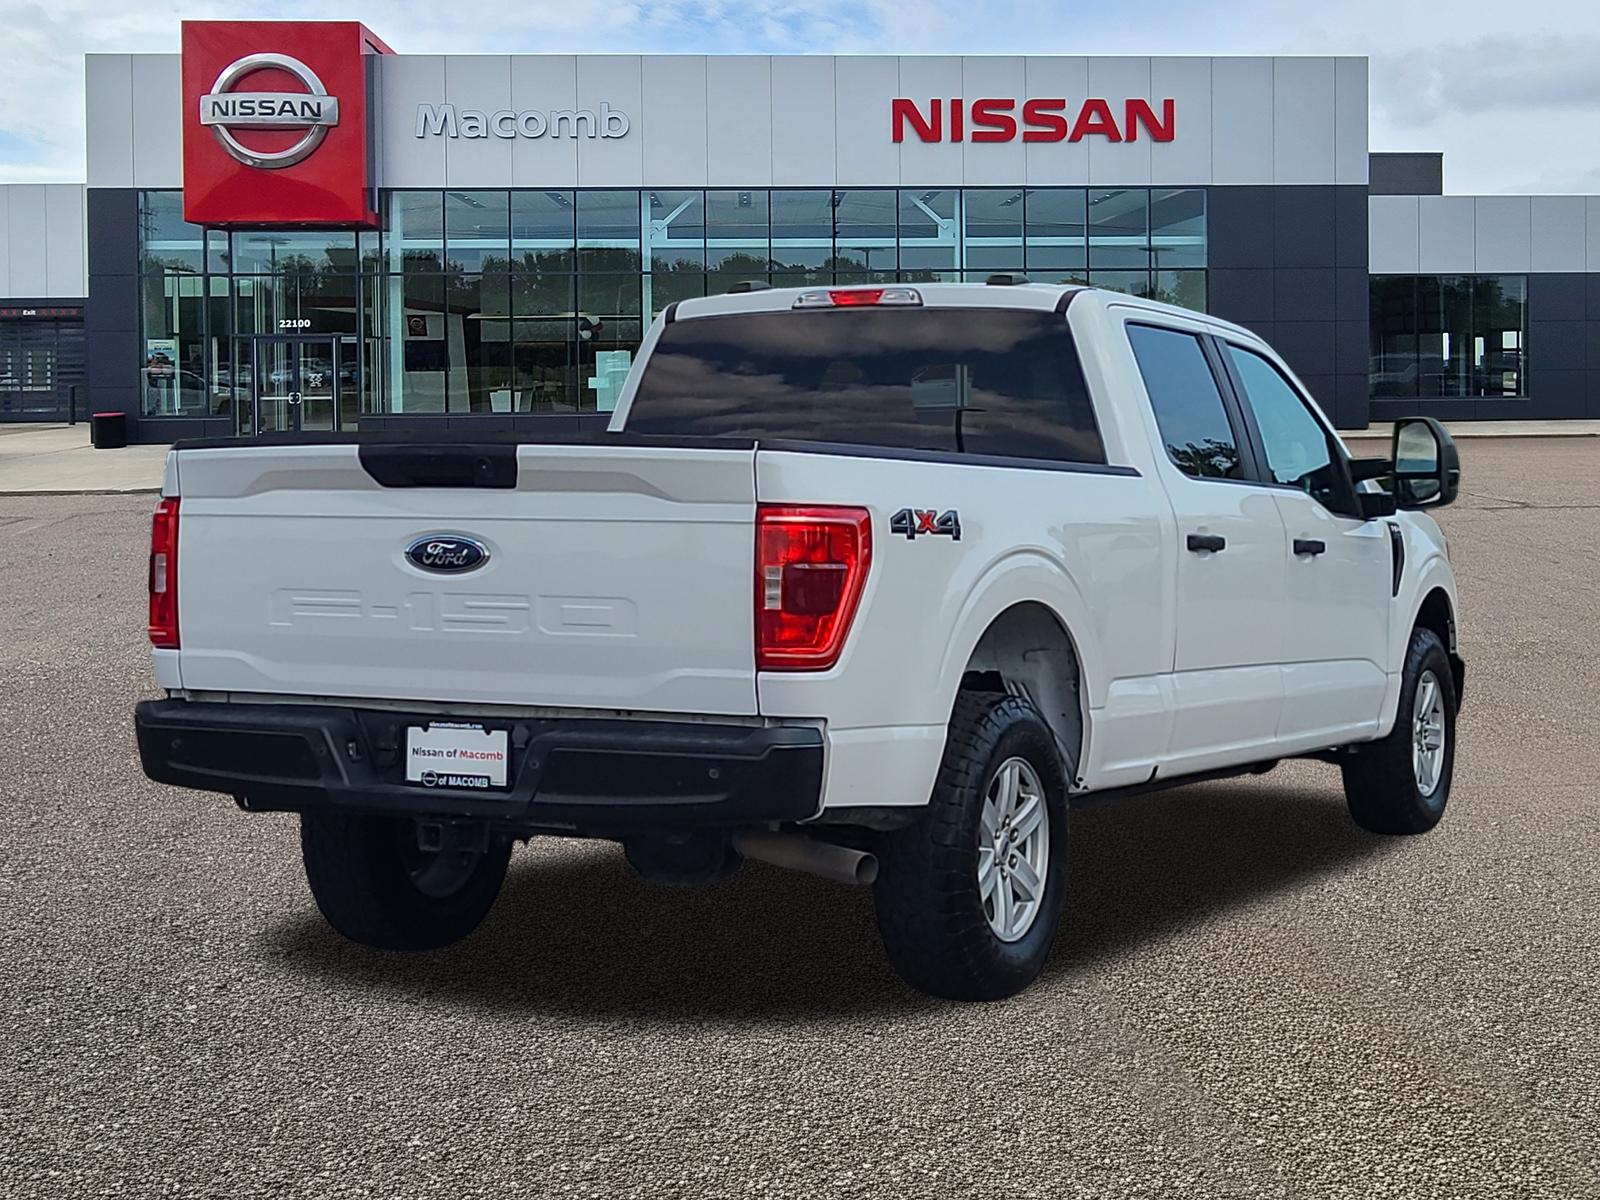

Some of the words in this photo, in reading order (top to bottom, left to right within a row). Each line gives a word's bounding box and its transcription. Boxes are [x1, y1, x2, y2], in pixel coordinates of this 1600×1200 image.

[212, 100, 322, 118] NISSAN
[415, 101, 631, 139] Macomb
[891, 98, 1176, 143] NISSAN
[279, 319, 311, 328] 22100
[422, 542, 469, 565] Ford
[269, 588, 638, 638] F-150
[411, 747, 444, 758] Nissan
[446, 748, 457, 758] of
[459, 750, 504, 761] Macomb
[438, 776, 447, 786] of
[448, 775, 489, 788] MACOMB
